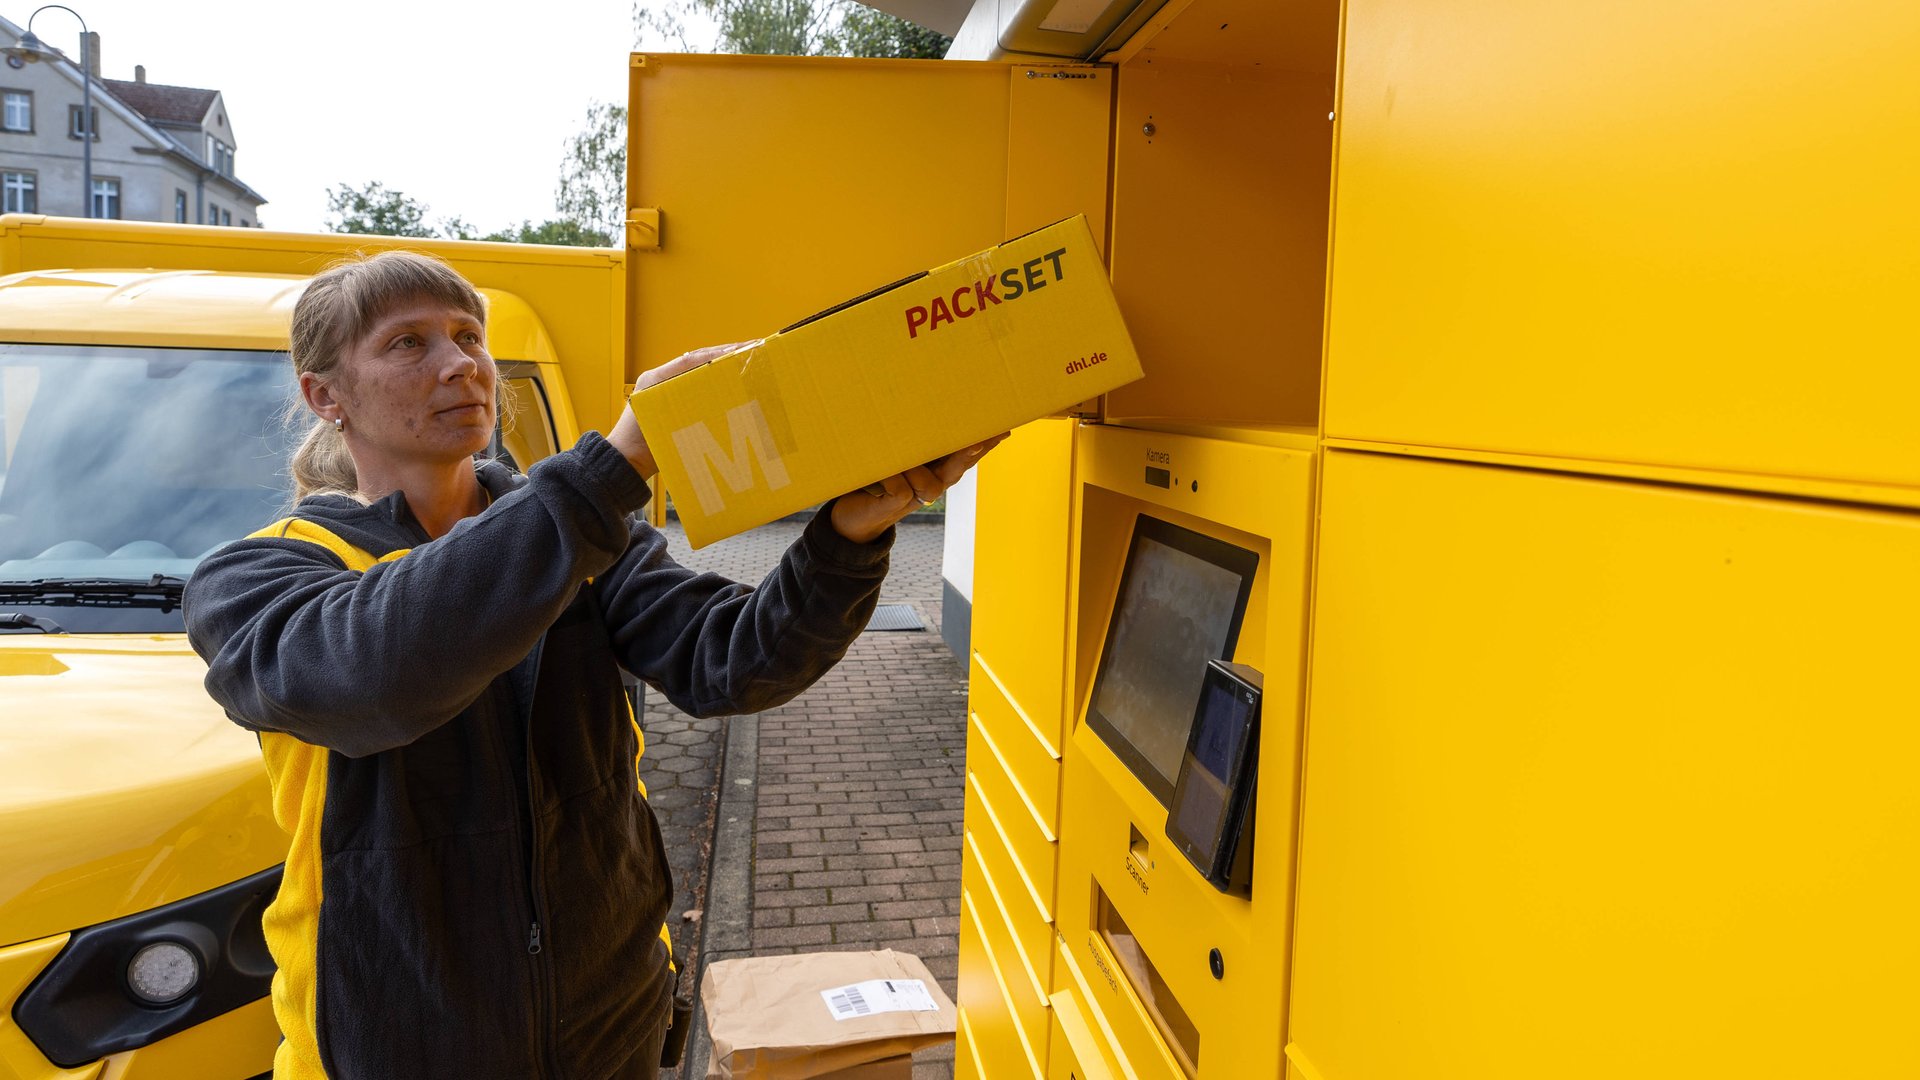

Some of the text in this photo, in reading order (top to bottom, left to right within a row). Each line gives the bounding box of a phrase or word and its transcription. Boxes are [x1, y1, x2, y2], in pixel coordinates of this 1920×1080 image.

[905, 247, 1067, 339] PACKSET
[1065, 352, 1108, 375] dhl.de
[671, 398, 792, 517] M
[1146, 447, 1170, 465] Kamera
[1125, 857, 1149, 896] Scanner
